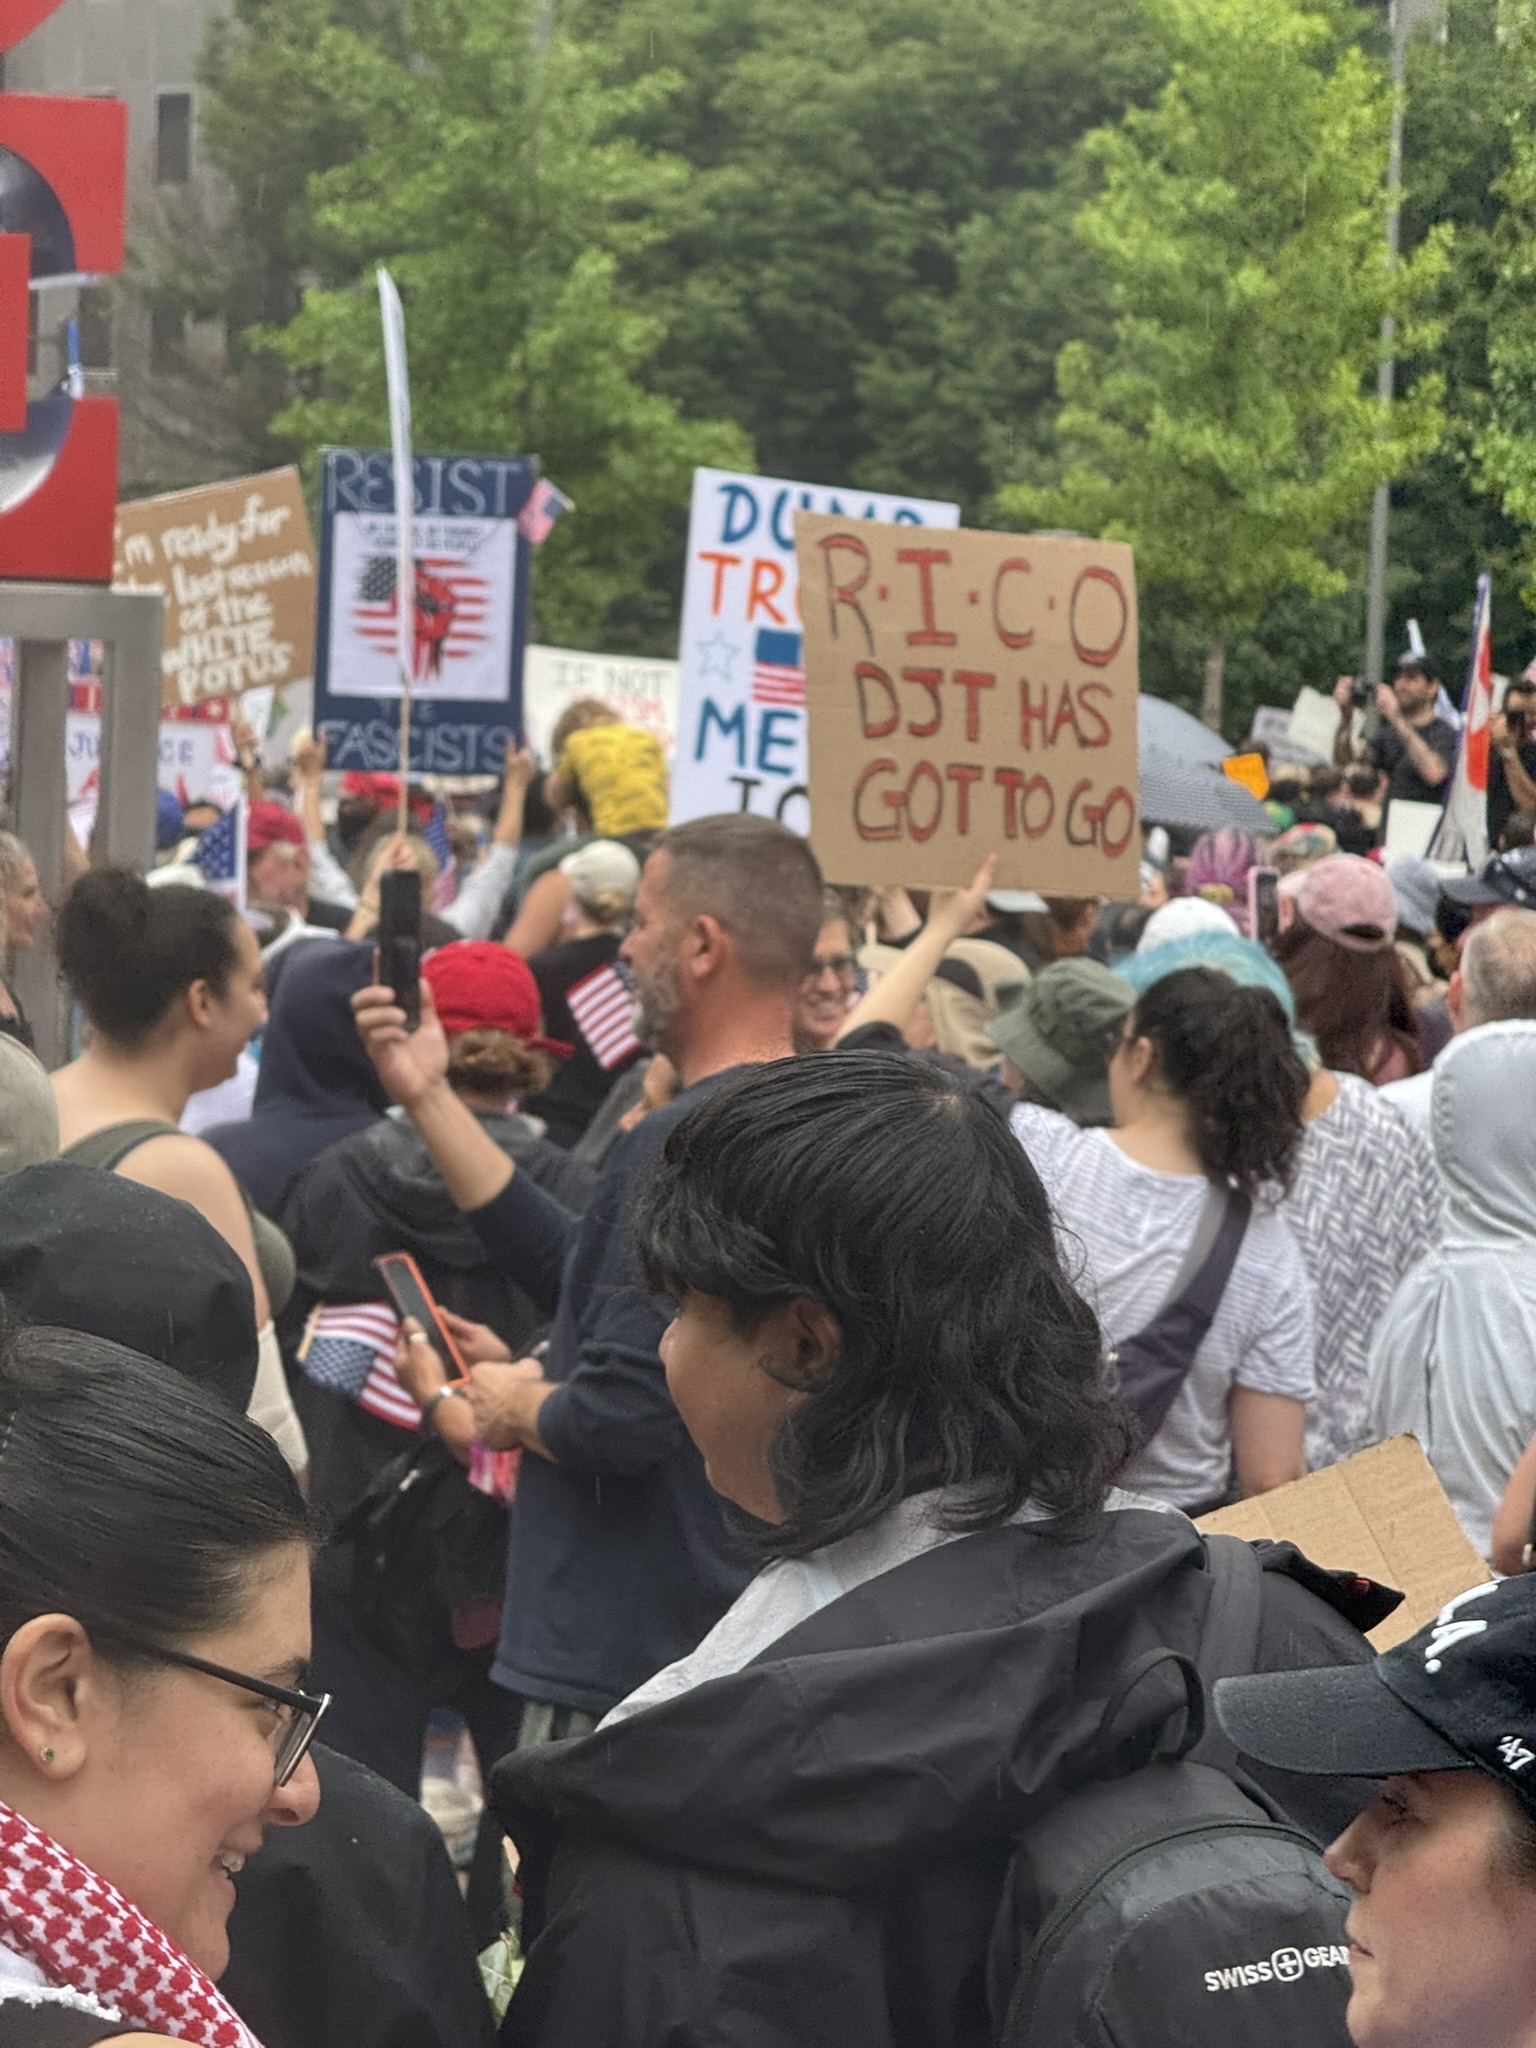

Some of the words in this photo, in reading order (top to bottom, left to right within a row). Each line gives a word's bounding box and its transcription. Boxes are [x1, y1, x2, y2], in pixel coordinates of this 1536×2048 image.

[161, 508, 239, 564] ready
[238, 493, 293, 543] for
[698, 552, 802, 625] TR
[855, 661, 996, 740] DJT
[1019, 678, 1112, 751] HAS
[854, 758, 983, 842] GOT
[994, 768, 1055, 841] TO
[1065, 778, 1136, 859] GO
[1204, 1961, 1273, 1992] SWISS
